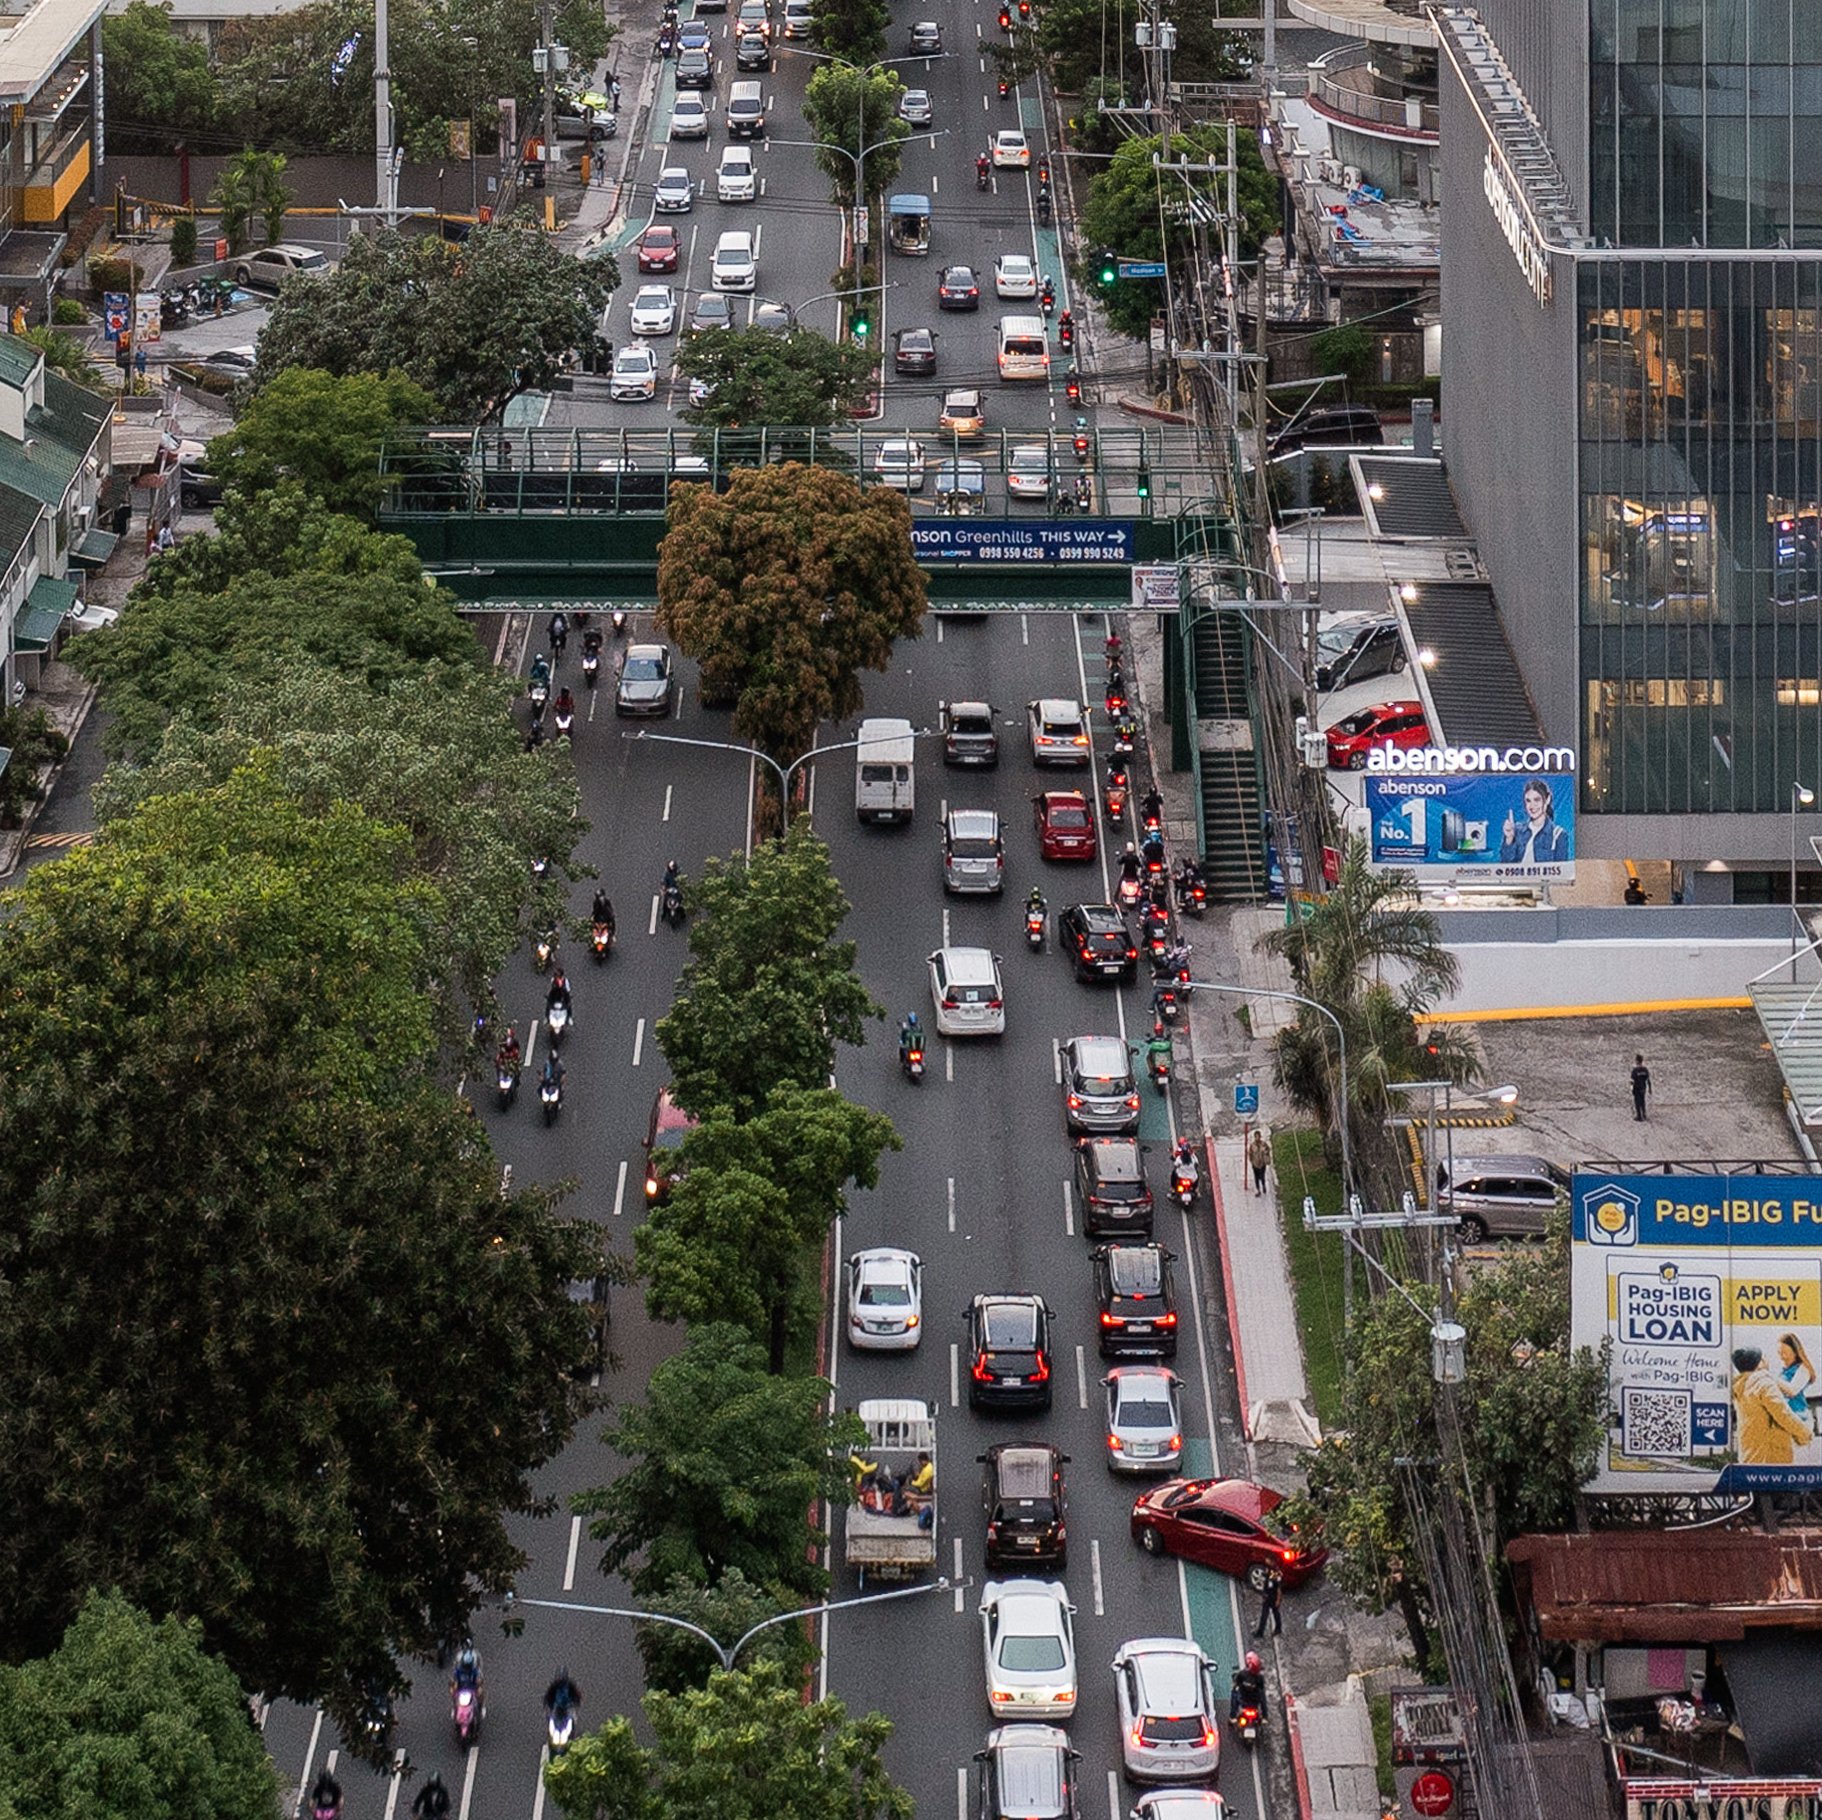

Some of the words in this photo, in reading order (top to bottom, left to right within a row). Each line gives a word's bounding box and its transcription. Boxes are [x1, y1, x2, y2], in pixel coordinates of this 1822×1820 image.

[910, 531, 951, 543] nson
[955, 530, 1033, 543] Greenhills
[1039, 531, 1071, 542] THIS
[1074, 531, 1105, 542] WAY
[1003, 547, 1021, 559] 550
[1367, 739, 1575, 771] abenson.com
[1378, 779, 1447, 795] abenson
[1380, 826, 1410, 839] No.
[1401, 798, 1426, 846] 1
[1505, 867, 1525, 877] 0908
[1526, 867, 1542, 876] 891
[1655, 1199, 1783, 1228] Pag-IBIG
[1628, 1285, 1712, 1303] Pag-IBIG
[1736, 1285, 1802, 1301] APPLY
[1629, 1303, 1712, 1318] HOUSING
[1740, 1305, 1798, 1321] NOW!
[1629, 1319, 1712, 1342] LOAN
[1623, 1349, 1679, 1366] Welcome
[1683, 1353, 1721, 1368] Home
[1654, 1370, 1714, 1383] Pag-IBIG
[1695, 1408, 1725, 1418] SCAN
[1696, 1418, 1725, 1428] HERE
